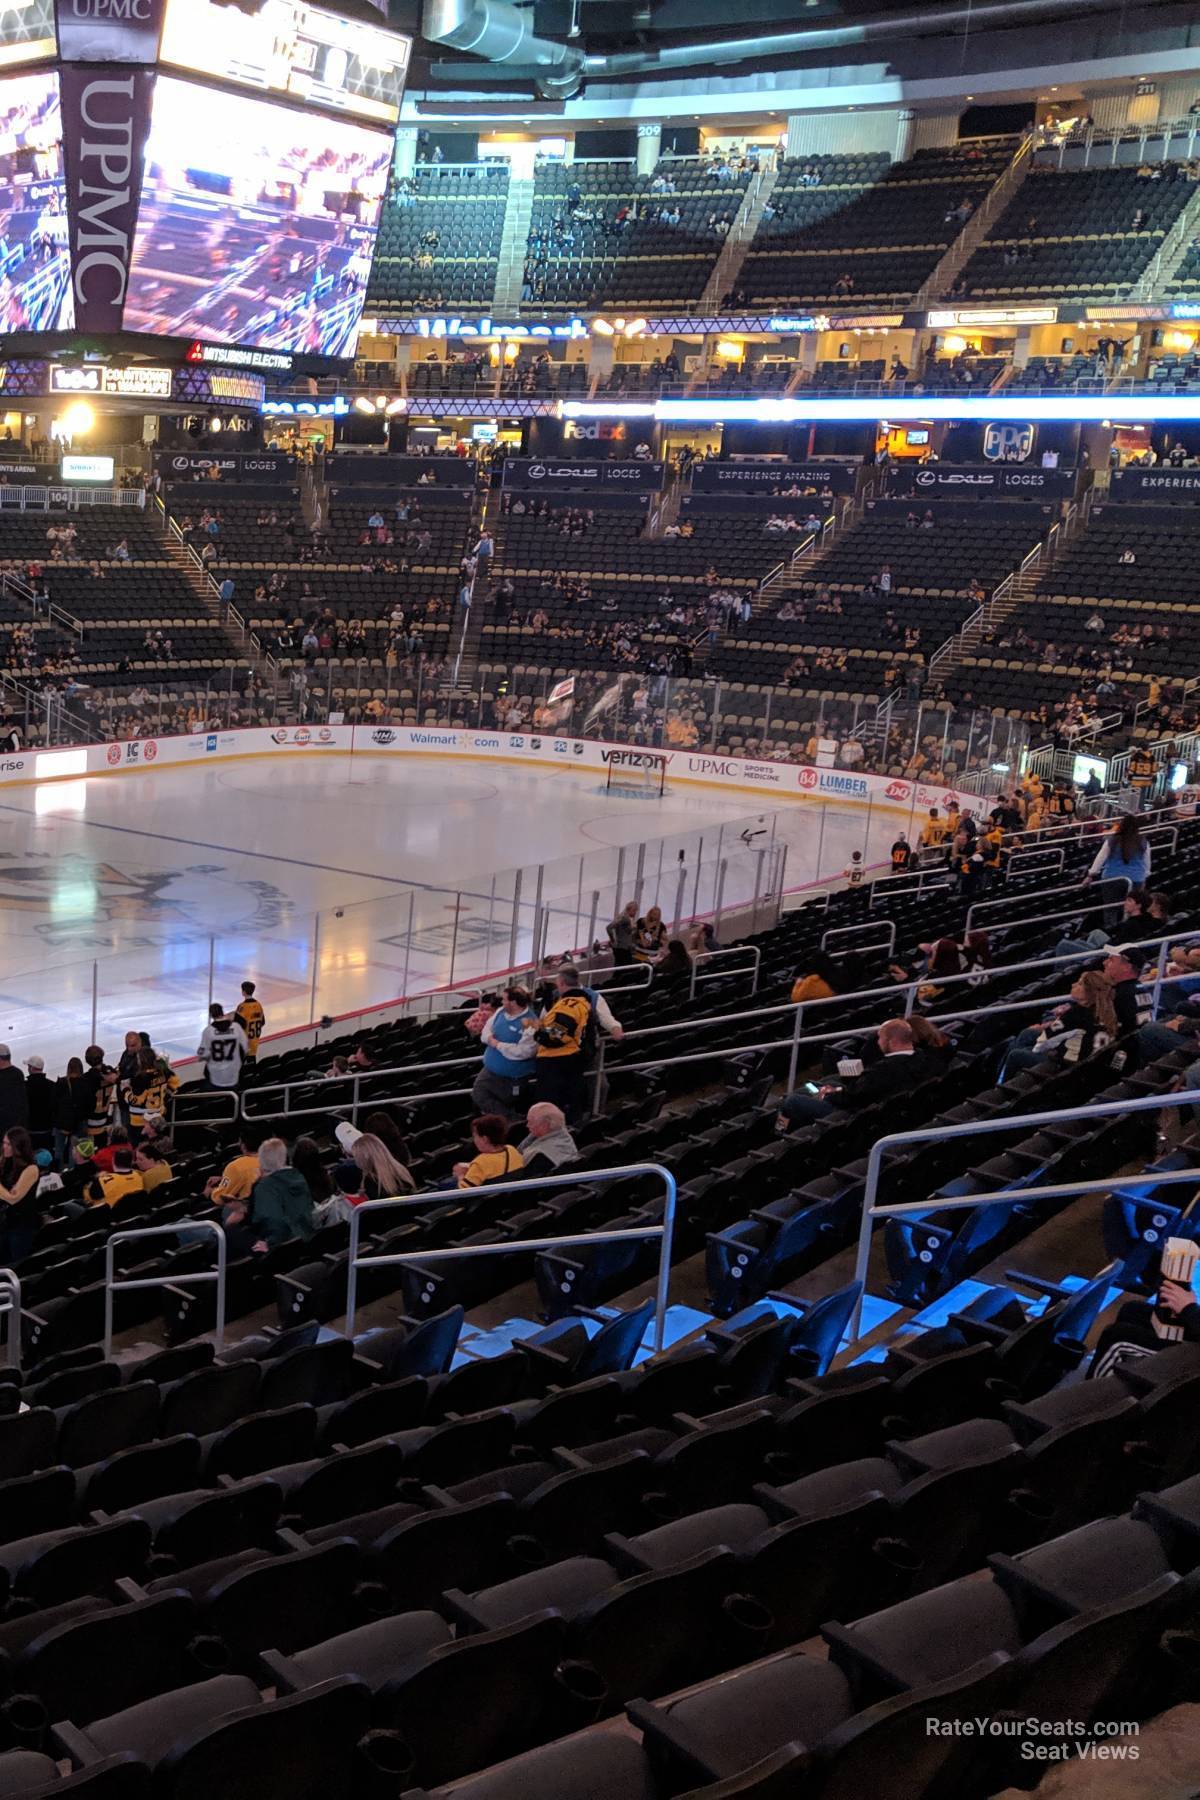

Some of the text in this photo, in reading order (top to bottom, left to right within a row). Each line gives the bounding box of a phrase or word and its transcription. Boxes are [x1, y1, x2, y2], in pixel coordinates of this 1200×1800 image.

[70, 0, 152, 20] UPMC
[637, 125, 662, 137] 209
[75, 75, 135, 306] UPMC
[770, 316, 816, 331] Walmart
[203, 346, 293, 369] MITSUBISHI ELECTRIC
[563, 420, 626, 440] FedEx
[14, 465, 36, 473] ARENA
[244, 460, 277, 471] LOGES
[607, 468, 641, 479] LOGES
[718, 471, 831, 482] EXPERIENCE AMAZING
[937, 474, 1045, 486] LEXUS LOGES
[1141, 477, 1200, 489] EXPERIEN
[50, 491, 68, 502] 104
[409, 732, 500, 748] Walmart com
[126, 742, 139, 758] IC
[600, 749, 666, 770] verizon
[688, 757, 739, 777] UPMC
[744, 764, 775, 774] SPORTS
[743, 772, 781, 782] MEDICINE
[799, 771, 868, 792] 84 LUMBER
[889, 785, 911, 800] DQ
[247, 1020, 262, 1040] 58
[210, 1038, 237, 1063] 87
